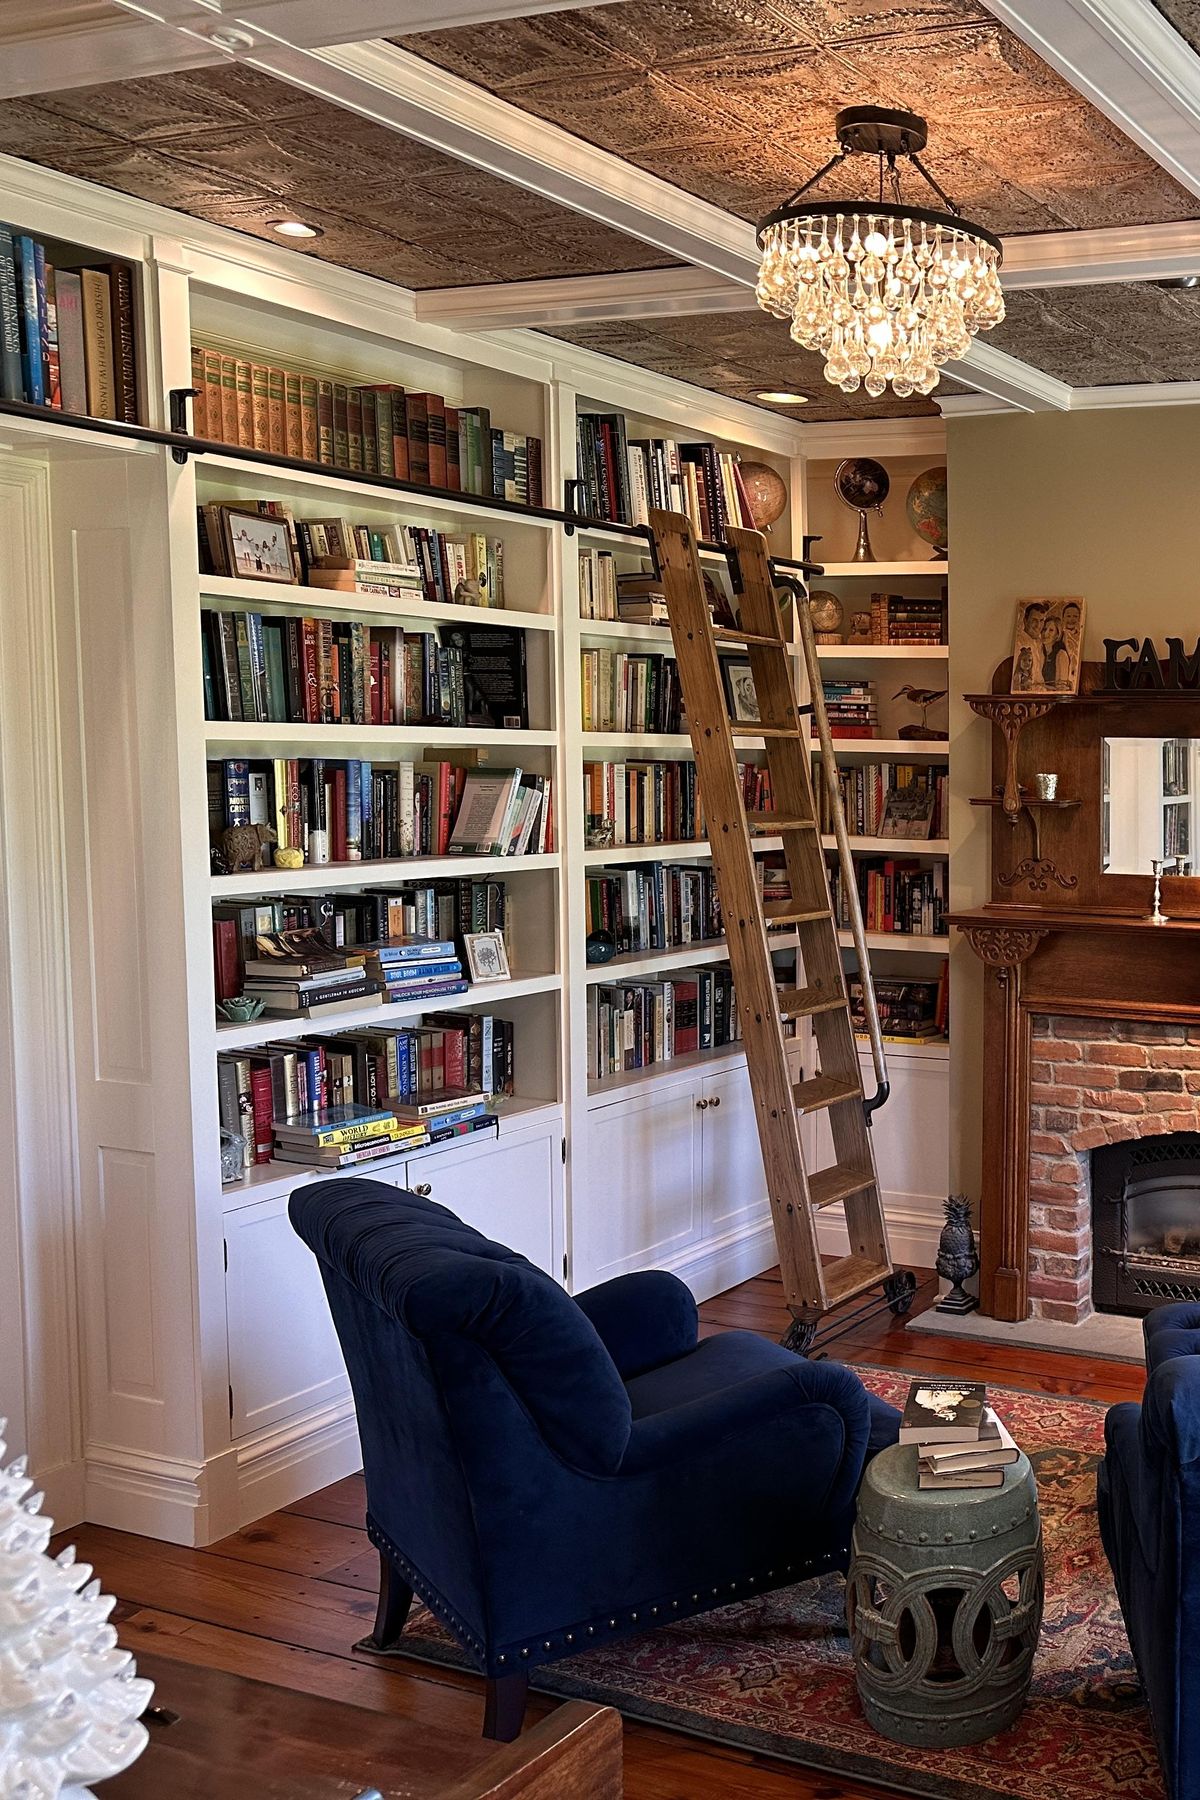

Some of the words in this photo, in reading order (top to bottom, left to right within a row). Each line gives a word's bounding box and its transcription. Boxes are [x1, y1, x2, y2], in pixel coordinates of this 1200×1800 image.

[6, 257, 16, 292] GREAT
[1, 285, 11, 321] WESTERN
[95, 284, 105, 322] HISTORY
[4, 323, 13, 352] WORLD
[9, 295, 20, 353] PAINTINGS
[98, 332, 106, 349] ART
[121, 329, 135, 384] HISTORY
[99, 382, 109, 417] JANSON
[124, 385, 136, 400] IN
[600, 439, 609, 465] World
[601, 468, 612, 514] Geography
[714, 478, 723, 527] SCOTLAND
[322, 622, 331, 635] DAN
[322, 637, 331, 659] BROWN
[289, 1074, 298, 1095] Help
[340, 1125, 368, 1137] WORLD
[342, 1132, 367, 1141] HISTORY
[354, 1136, 390, 1149] Microeconomics
